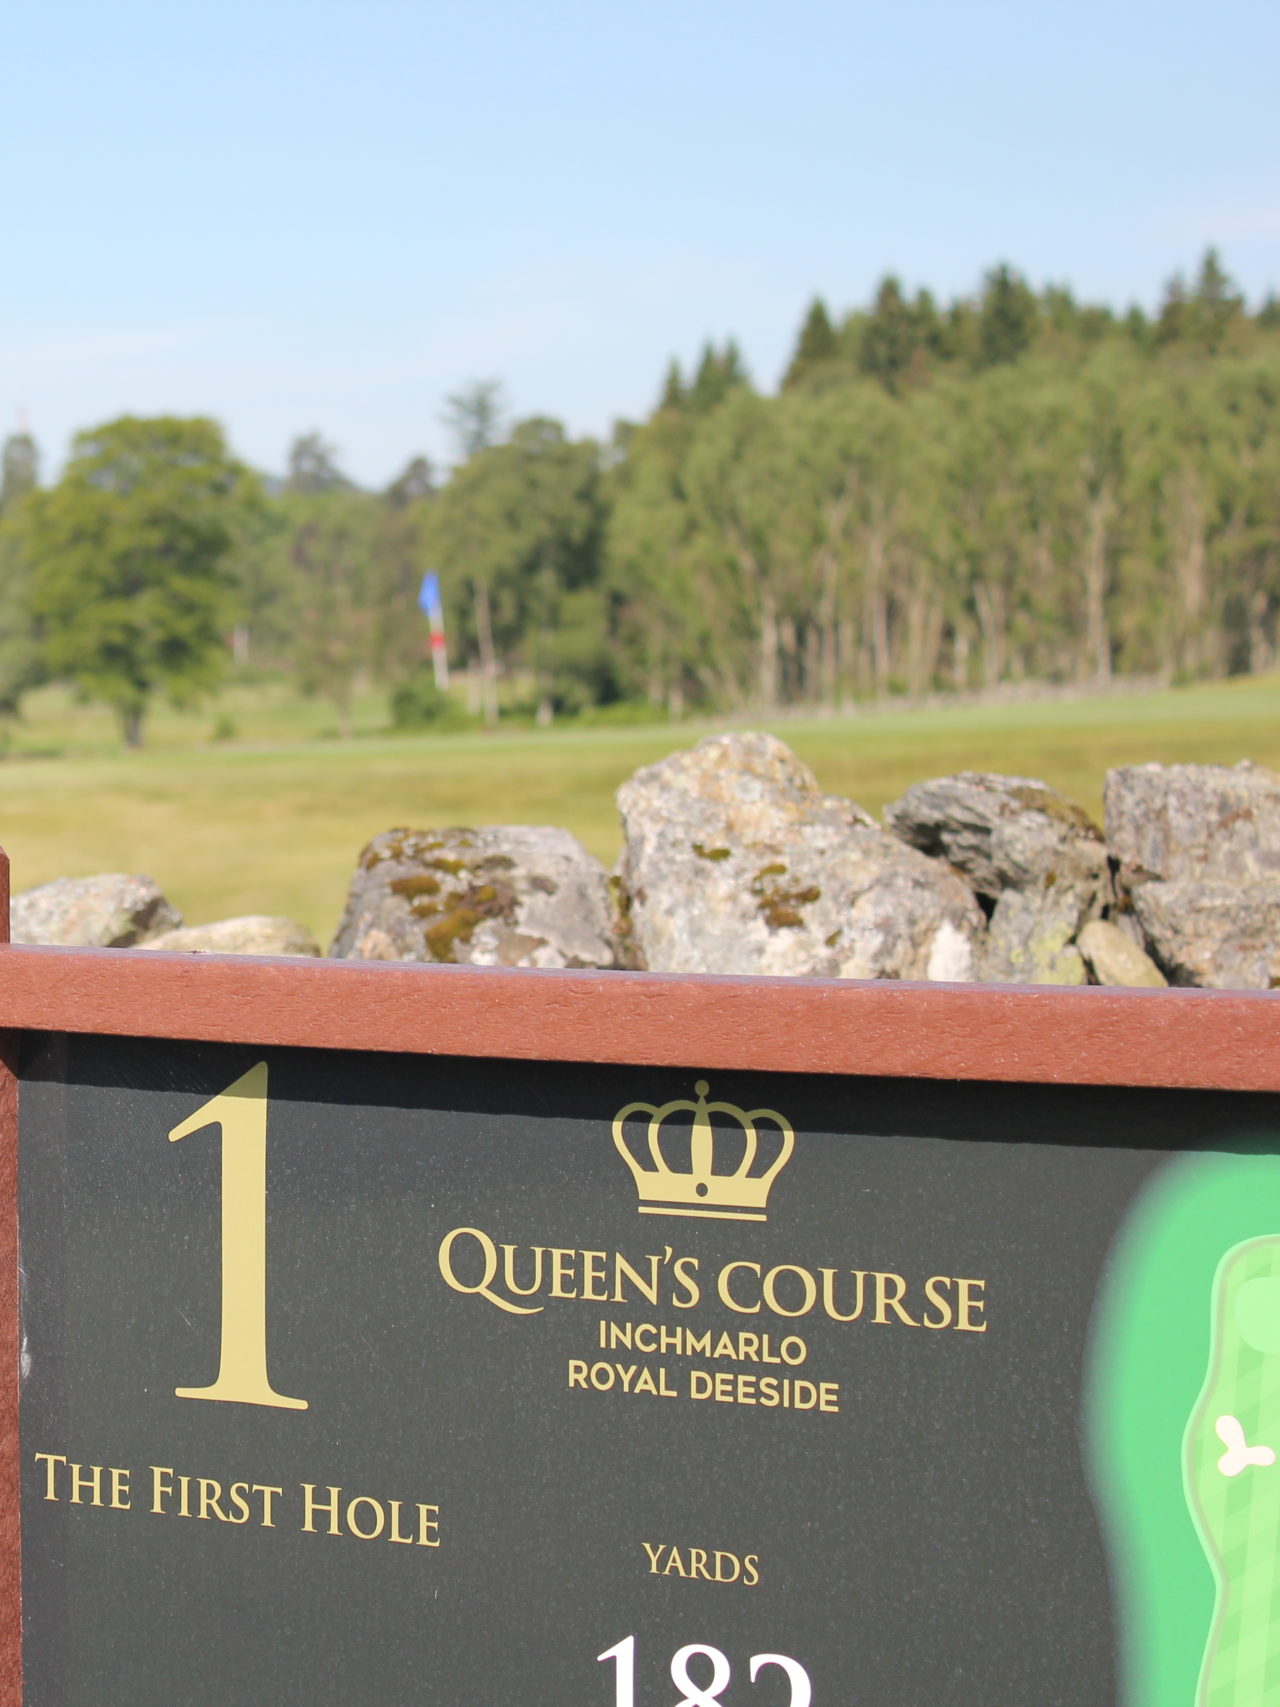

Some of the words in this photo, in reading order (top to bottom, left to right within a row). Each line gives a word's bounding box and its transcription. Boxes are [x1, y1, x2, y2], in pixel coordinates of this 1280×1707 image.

[167, 1060, 309, 1411] 1
[717, 1260, 988, 1333] COURSE
[599, 1319, 808, 1366] INCHMARLO
[568, 1359, 678, 1398] ROYAL
[690, 1369, 840, 1413] DEESIDE
[641, 1542, 760, 1586] YARDS
